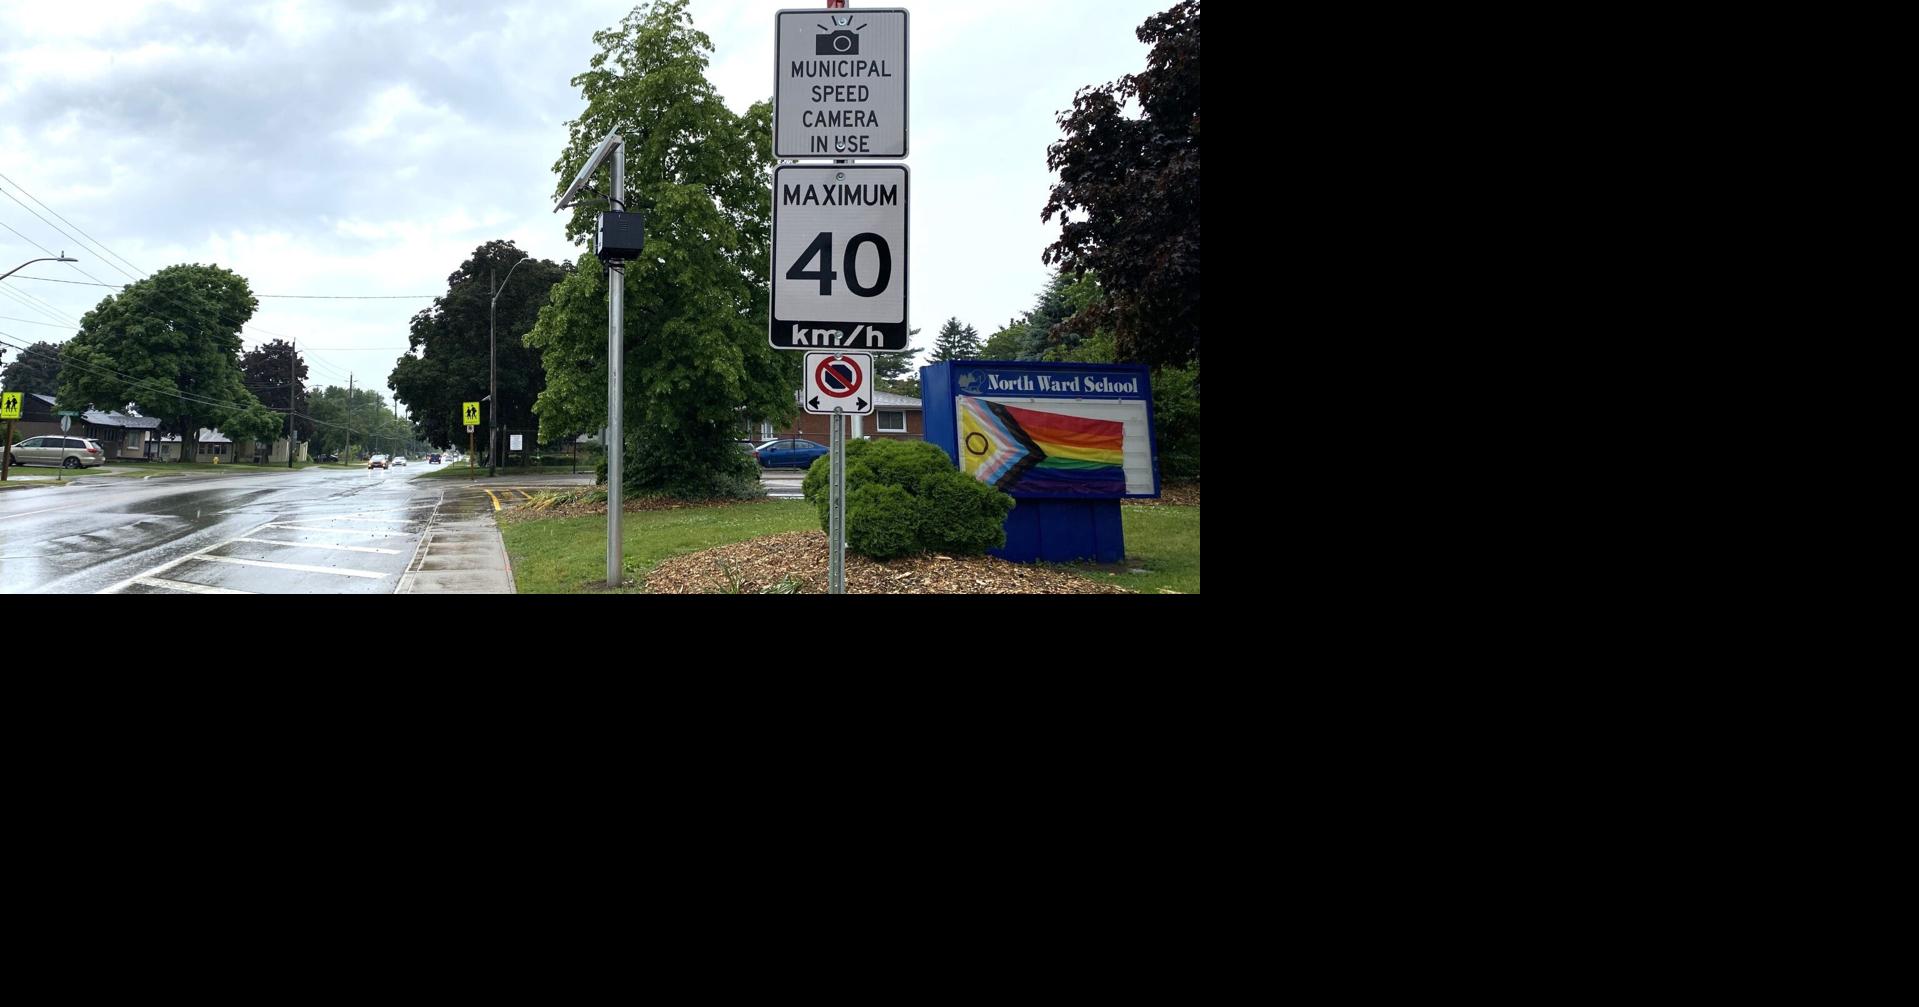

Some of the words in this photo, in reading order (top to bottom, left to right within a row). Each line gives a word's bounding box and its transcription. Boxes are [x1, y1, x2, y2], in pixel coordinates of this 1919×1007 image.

[791, 60, 892, 78] MUNICIPAL
[811, 85, 869, 103] SPEED
[802, 110, 879, 128] CAMERA
[810, 135, 828, 153] IN
[834, 135, 870, 153] USE
[783, 184, 898, 206] MAXIMUM
[786, 231, 892, 298] 40
[792, 323, 884, 348] km/h
[987, 374, 1034, 391] North
[1037, 375, 1080, 392] Ward
[1083, 376, 1138, 393] School
